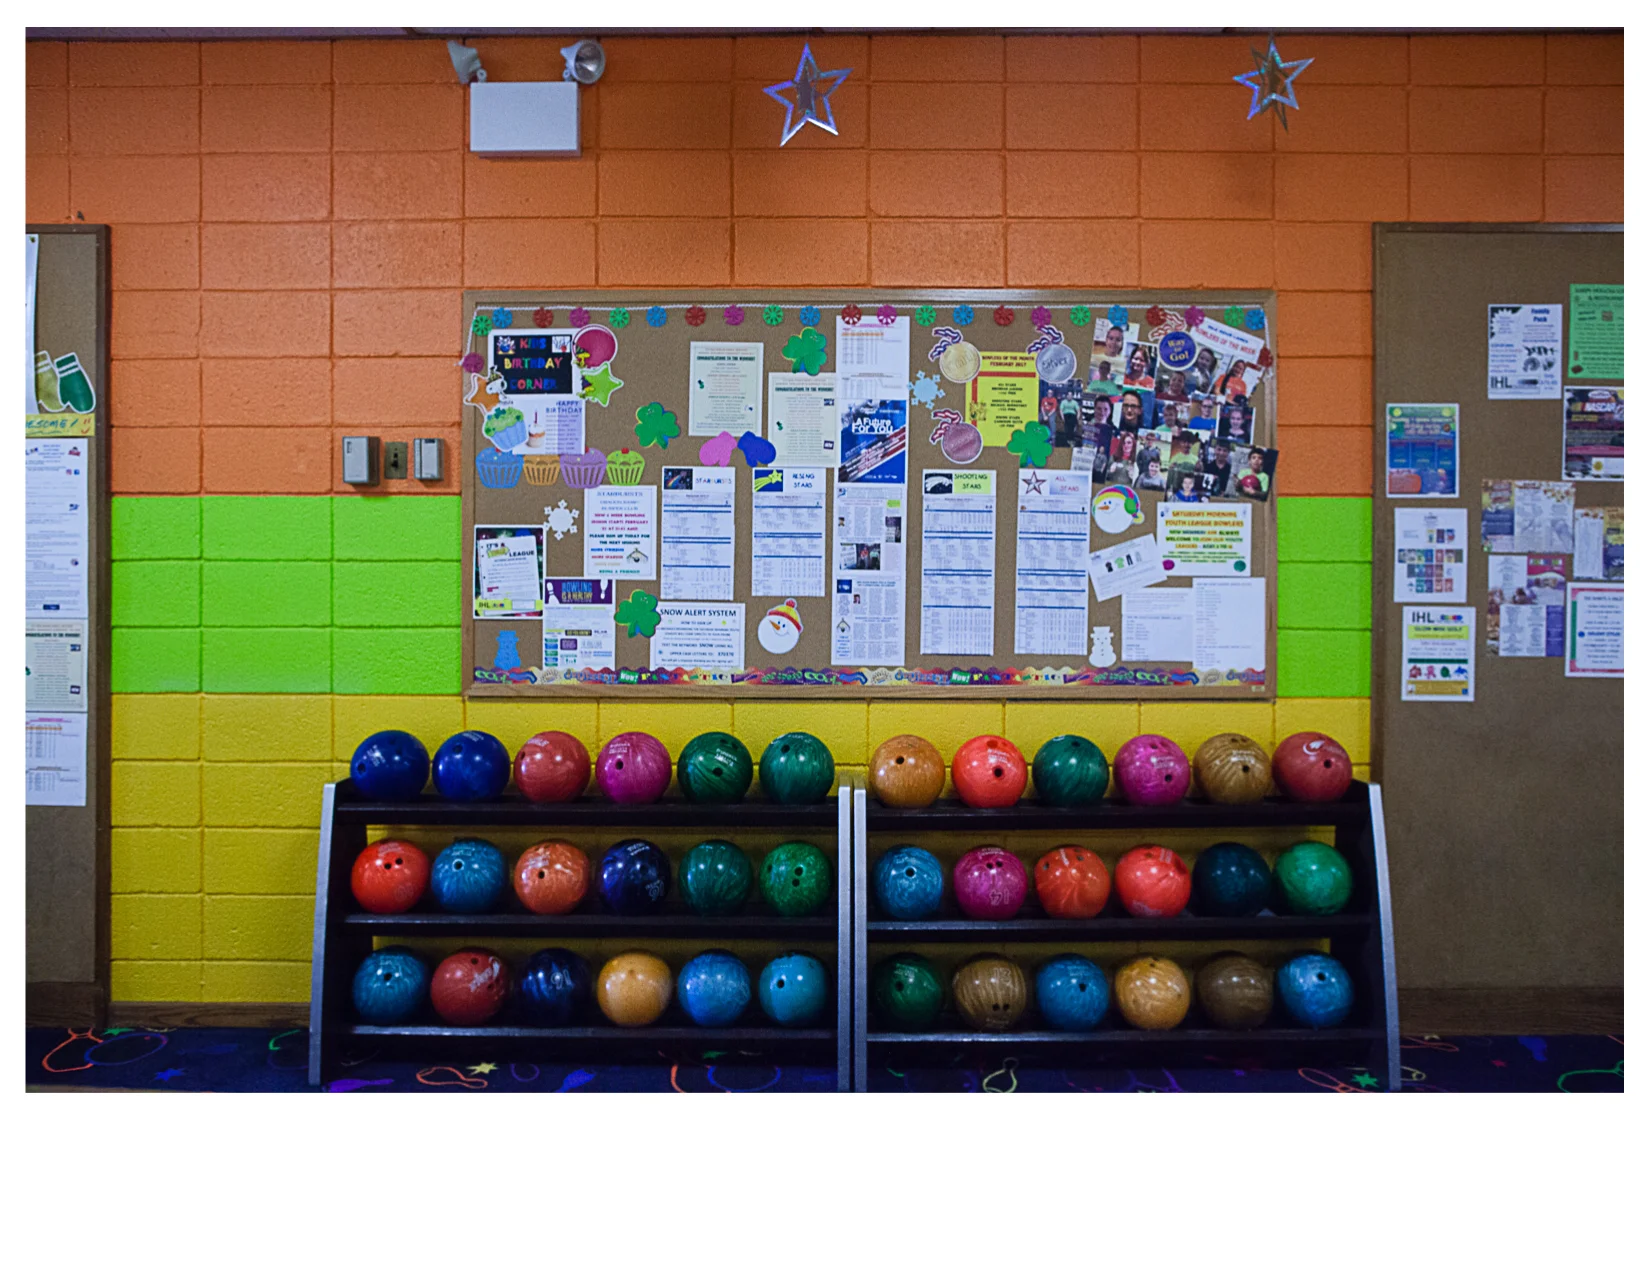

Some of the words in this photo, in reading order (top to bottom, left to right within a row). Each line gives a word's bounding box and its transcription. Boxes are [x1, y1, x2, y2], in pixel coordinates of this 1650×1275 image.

[520, 338, 546, 349] KIDS
[1168, 340, 1185, 348] Way
[1169, 351, 1189, 361] Go!
[504, 357, 563, 369] BIRTHDAY
[1042, 357, 1068, 370] Silver
[510, 379, 557, 390] CORNER
[1490, 376, 1512, 388] IHL
[864, 417, 891, 426] Future
[852, 423, 870, 433] For
[509, 550, 534, 558] LEAGUE
[562, 582, 592, 592] BOWLING
[572, 592, 592, 600] HEALTHY
[660, 608, 683, 616] SNOW
[1412, 612, 1435, 624] IHL
[621, 672, 638, 683] Wow!
[953, 672, 970, 683] Wow!
